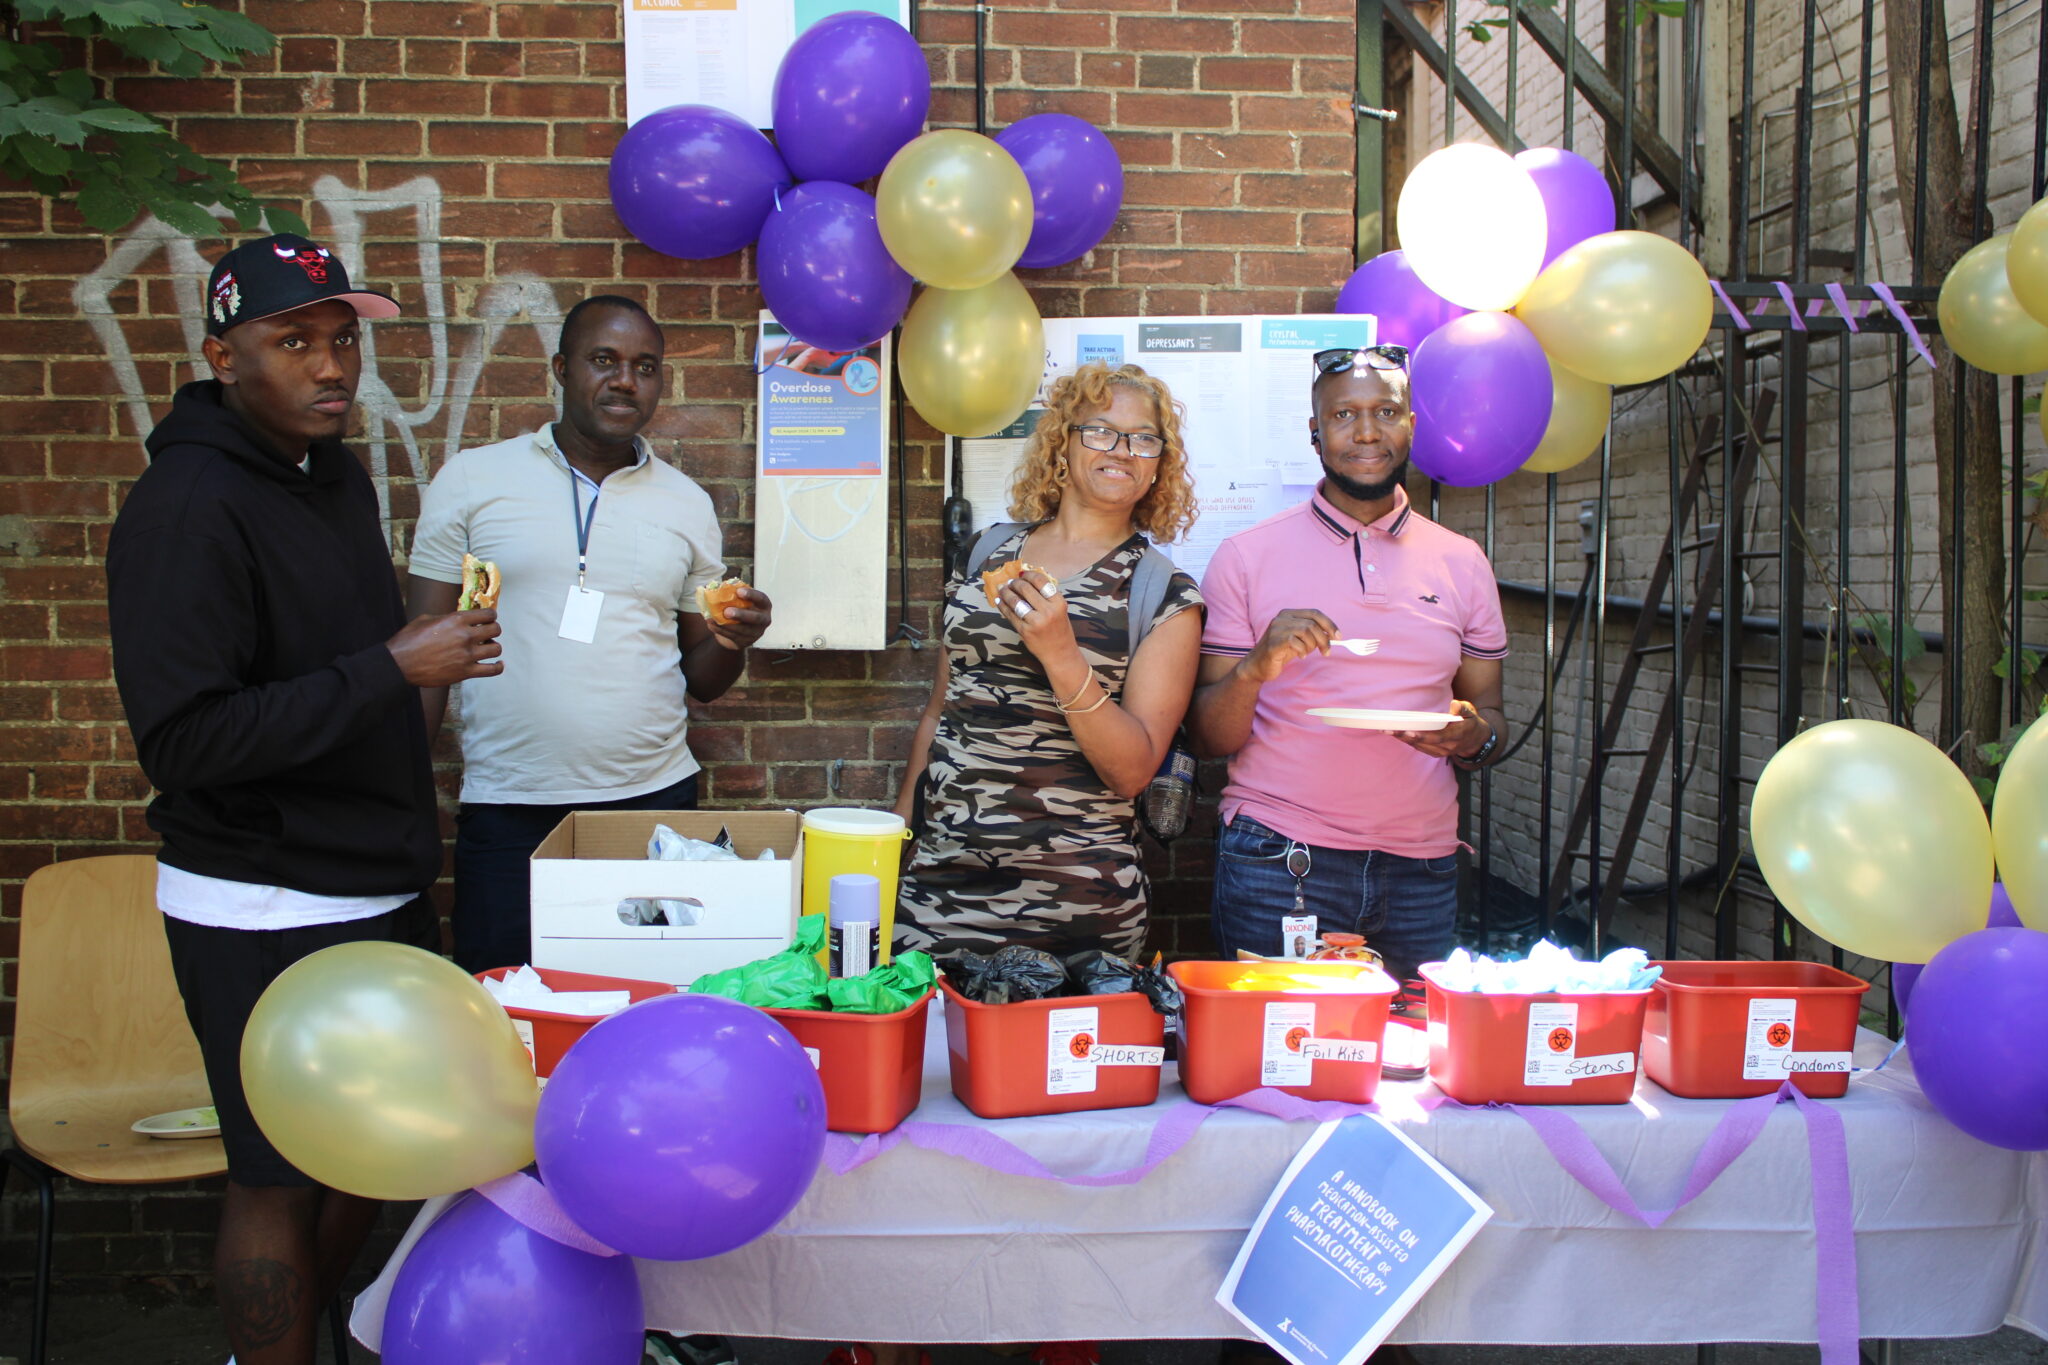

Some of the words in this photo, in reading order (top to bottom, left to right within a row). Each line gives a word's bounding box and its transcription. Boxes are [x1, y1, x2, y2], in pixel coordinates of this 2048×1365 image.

[1146, 338, 1195, 349] DEPRESSANTS
[769, 381, 832, 393] Overdose
[769, 393, 834, 404] Awareness
[1285, 924, 1309, 932] DIXON
[1091, 1047, 1159, 1063] SHORTS
[1303, 1044, 1331, 1058] Foil
[1338, 1046, 1364, 1061] Kits
[1565, 1060, 1625, 1075] Stems
[1781, 1055, 1846, 1072] Condoms
[1331, 1170, 1345, 1183] A
[1342, 1179, 1399, 1231] HANDBOOK
[1399, 1228, 1420, 1249] ON
[1318, 1180, 1409, 1263] MEDICATION-ASSISTED
[1310, 1197, 1382, 1261] TREATMENT
[1377, 1261, 1392, 1276] OR
[1285, 1205, 1388, 1296] PHARMACOTHERAPY
